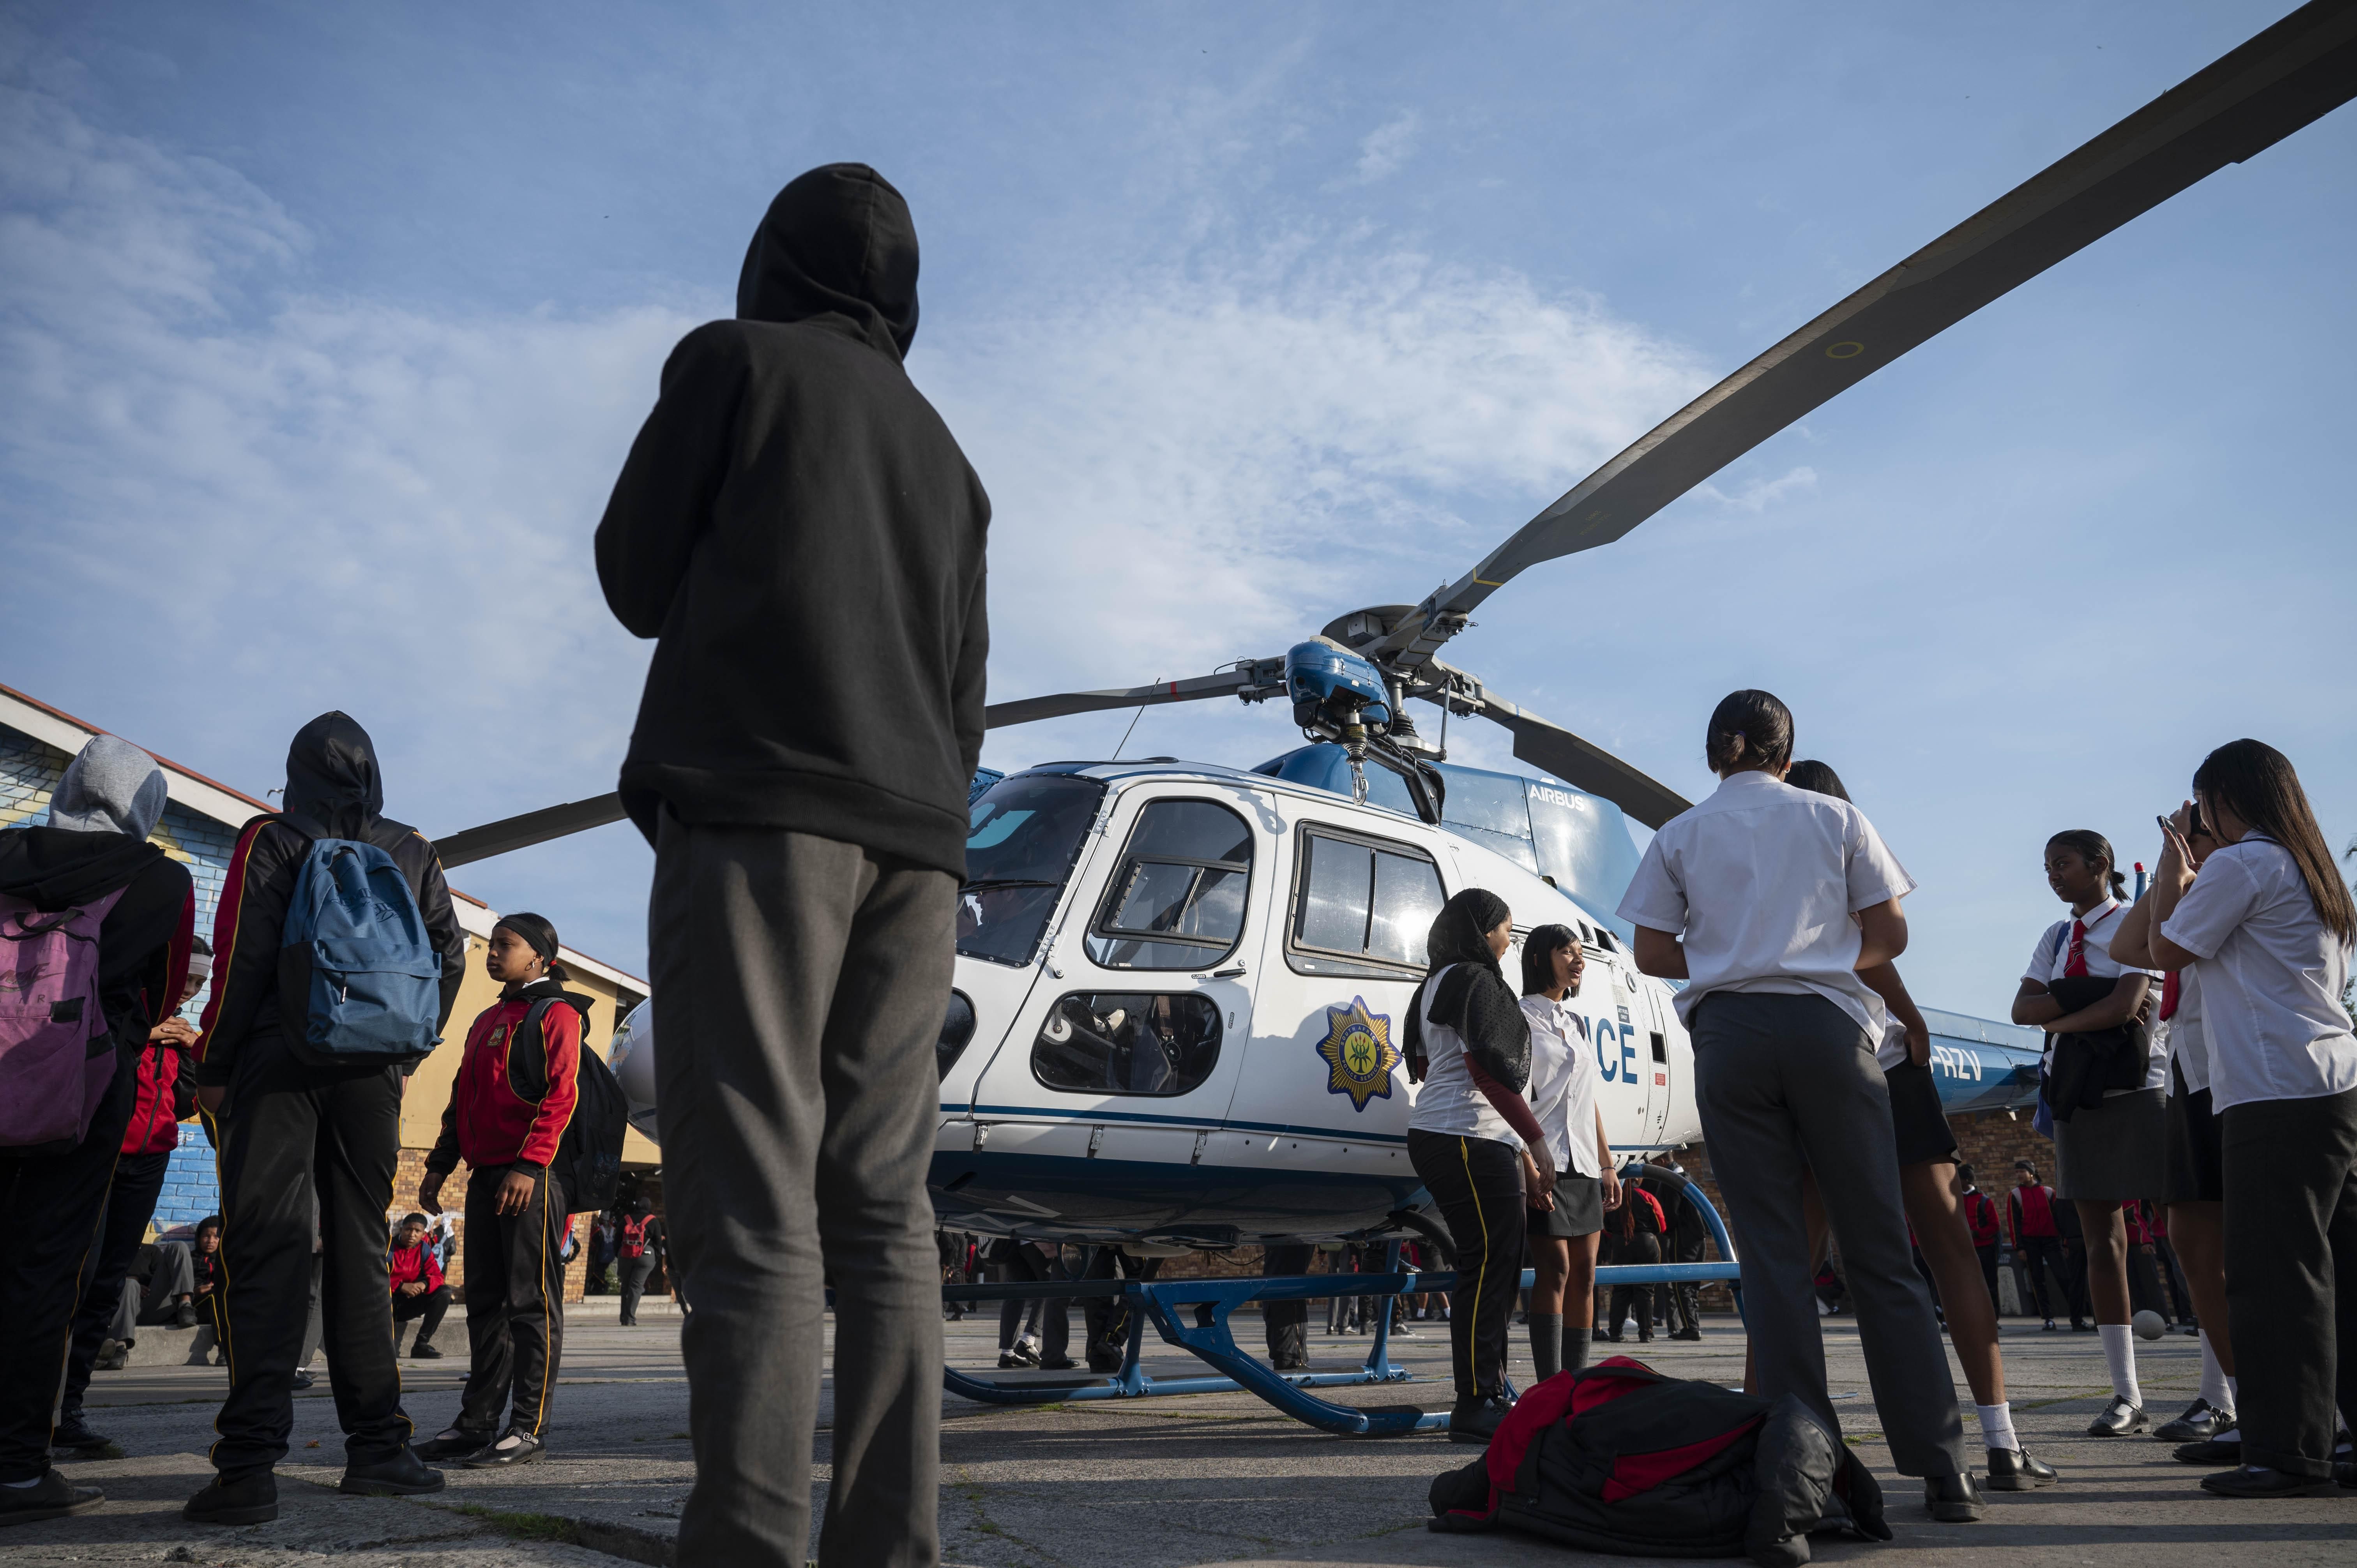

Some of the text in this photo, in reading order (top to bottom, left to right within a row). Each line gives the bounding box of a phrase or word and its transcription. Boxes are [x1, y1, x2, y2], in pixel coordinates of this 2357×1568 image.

[1530, 784, 1584, 812] AIRBUS
[1340, 1026, 1380, 1051] SOUTH AFRICAN
[1342, 1059, 1379, 1081] POLICE SERVICE
[1929, 1045, 1981, 1081] -RZV
